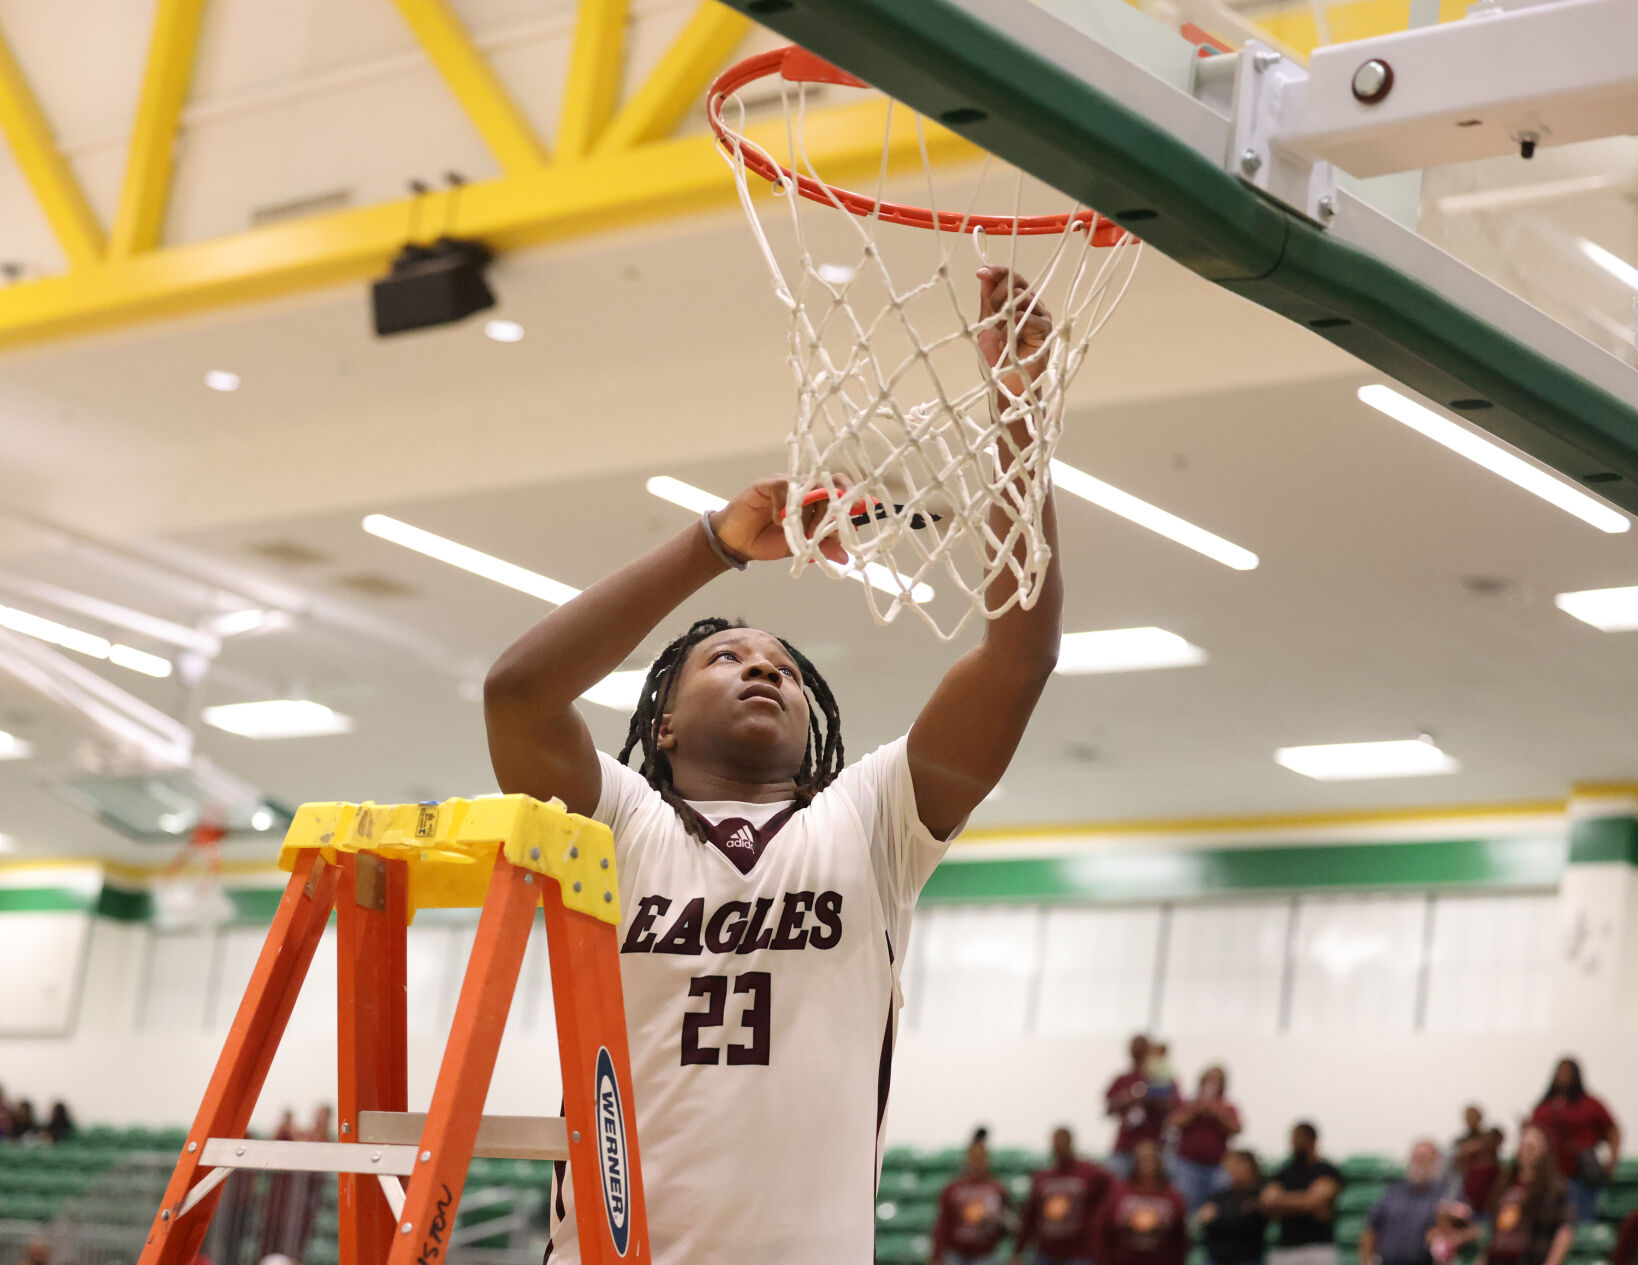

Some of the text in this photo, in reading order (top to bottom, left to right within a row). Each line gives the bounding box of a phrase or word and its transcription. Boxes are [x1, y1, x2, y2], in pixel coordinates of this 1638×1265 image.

[726, 838, 755, 854] adid
[620, 891, 843, 955] EAGLES
[681, 971, 771, 1066] 23
[602, 1091, 623, 1214] WERNER
